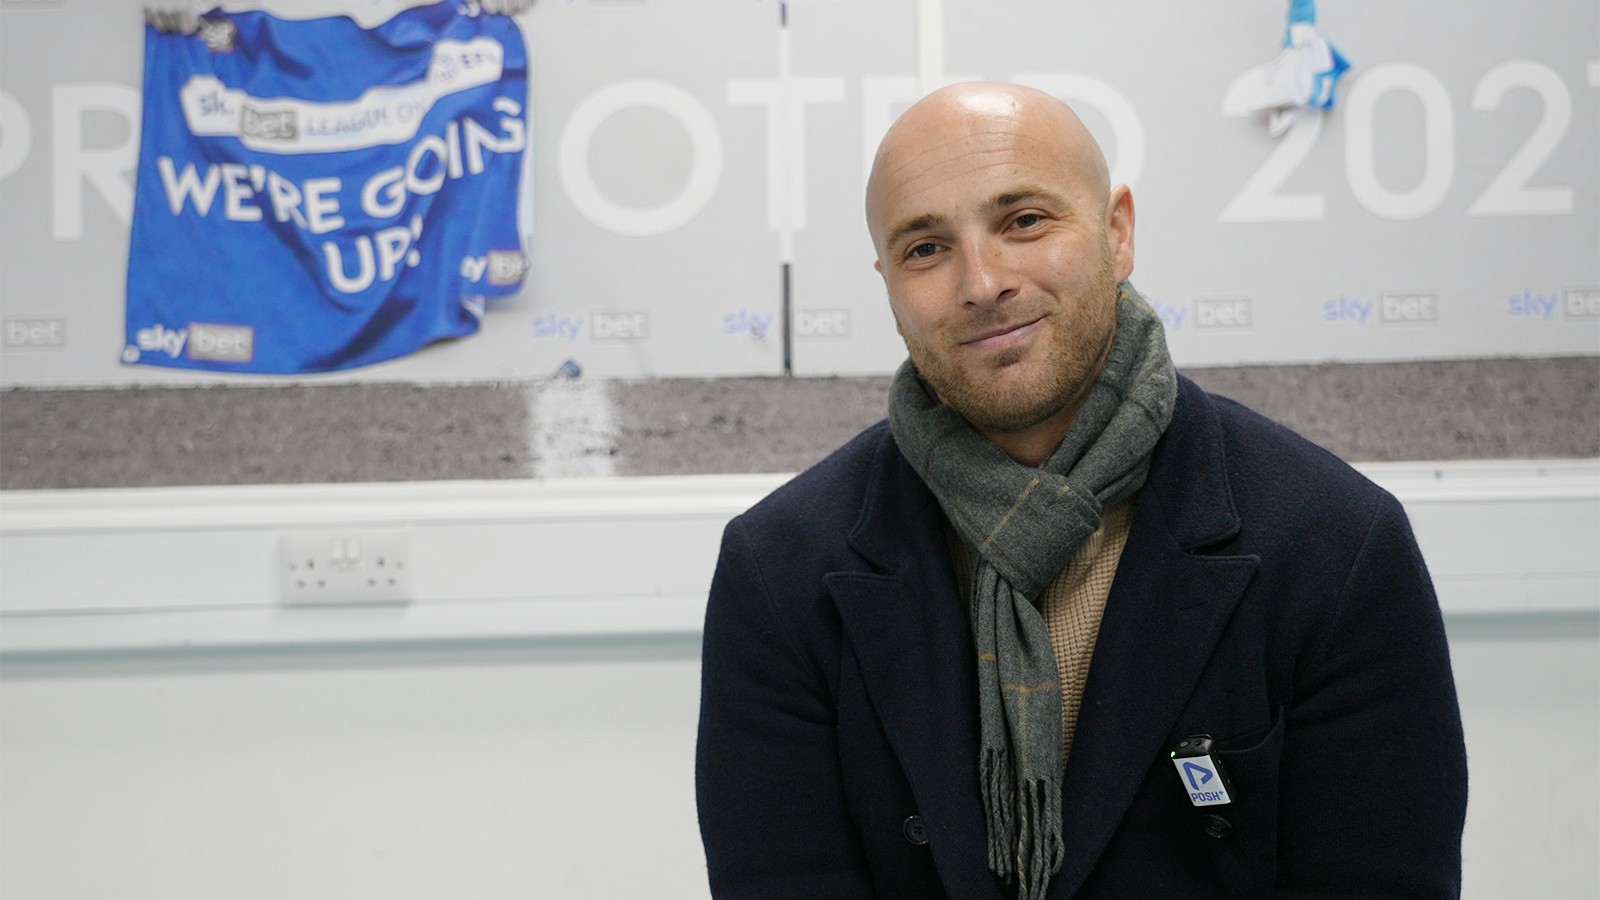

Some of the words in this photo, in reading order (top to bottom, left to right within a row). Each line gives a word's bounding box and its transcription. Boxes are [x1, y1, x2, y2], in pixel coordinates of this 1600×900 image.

[158, 156, 346, 235] WE'RE
[360, 96, 527, 219] GOING
[1198, 300, 1250, 326] bet
[1322, 294, 1375, 325] sky
[1382, 295, 1437, 322] bet
[1507, 289, 1560, 319] sky
[1567, 291, 1600, 317] be
[530, 312, 585, 341] sky
[595, 313, 647, 339] bet
[721, 308, 774, 338] sky
[798, 309, 848, 335] bet
[136, 322, 188, 359] sky
[195, 326, 250, 358] bet
